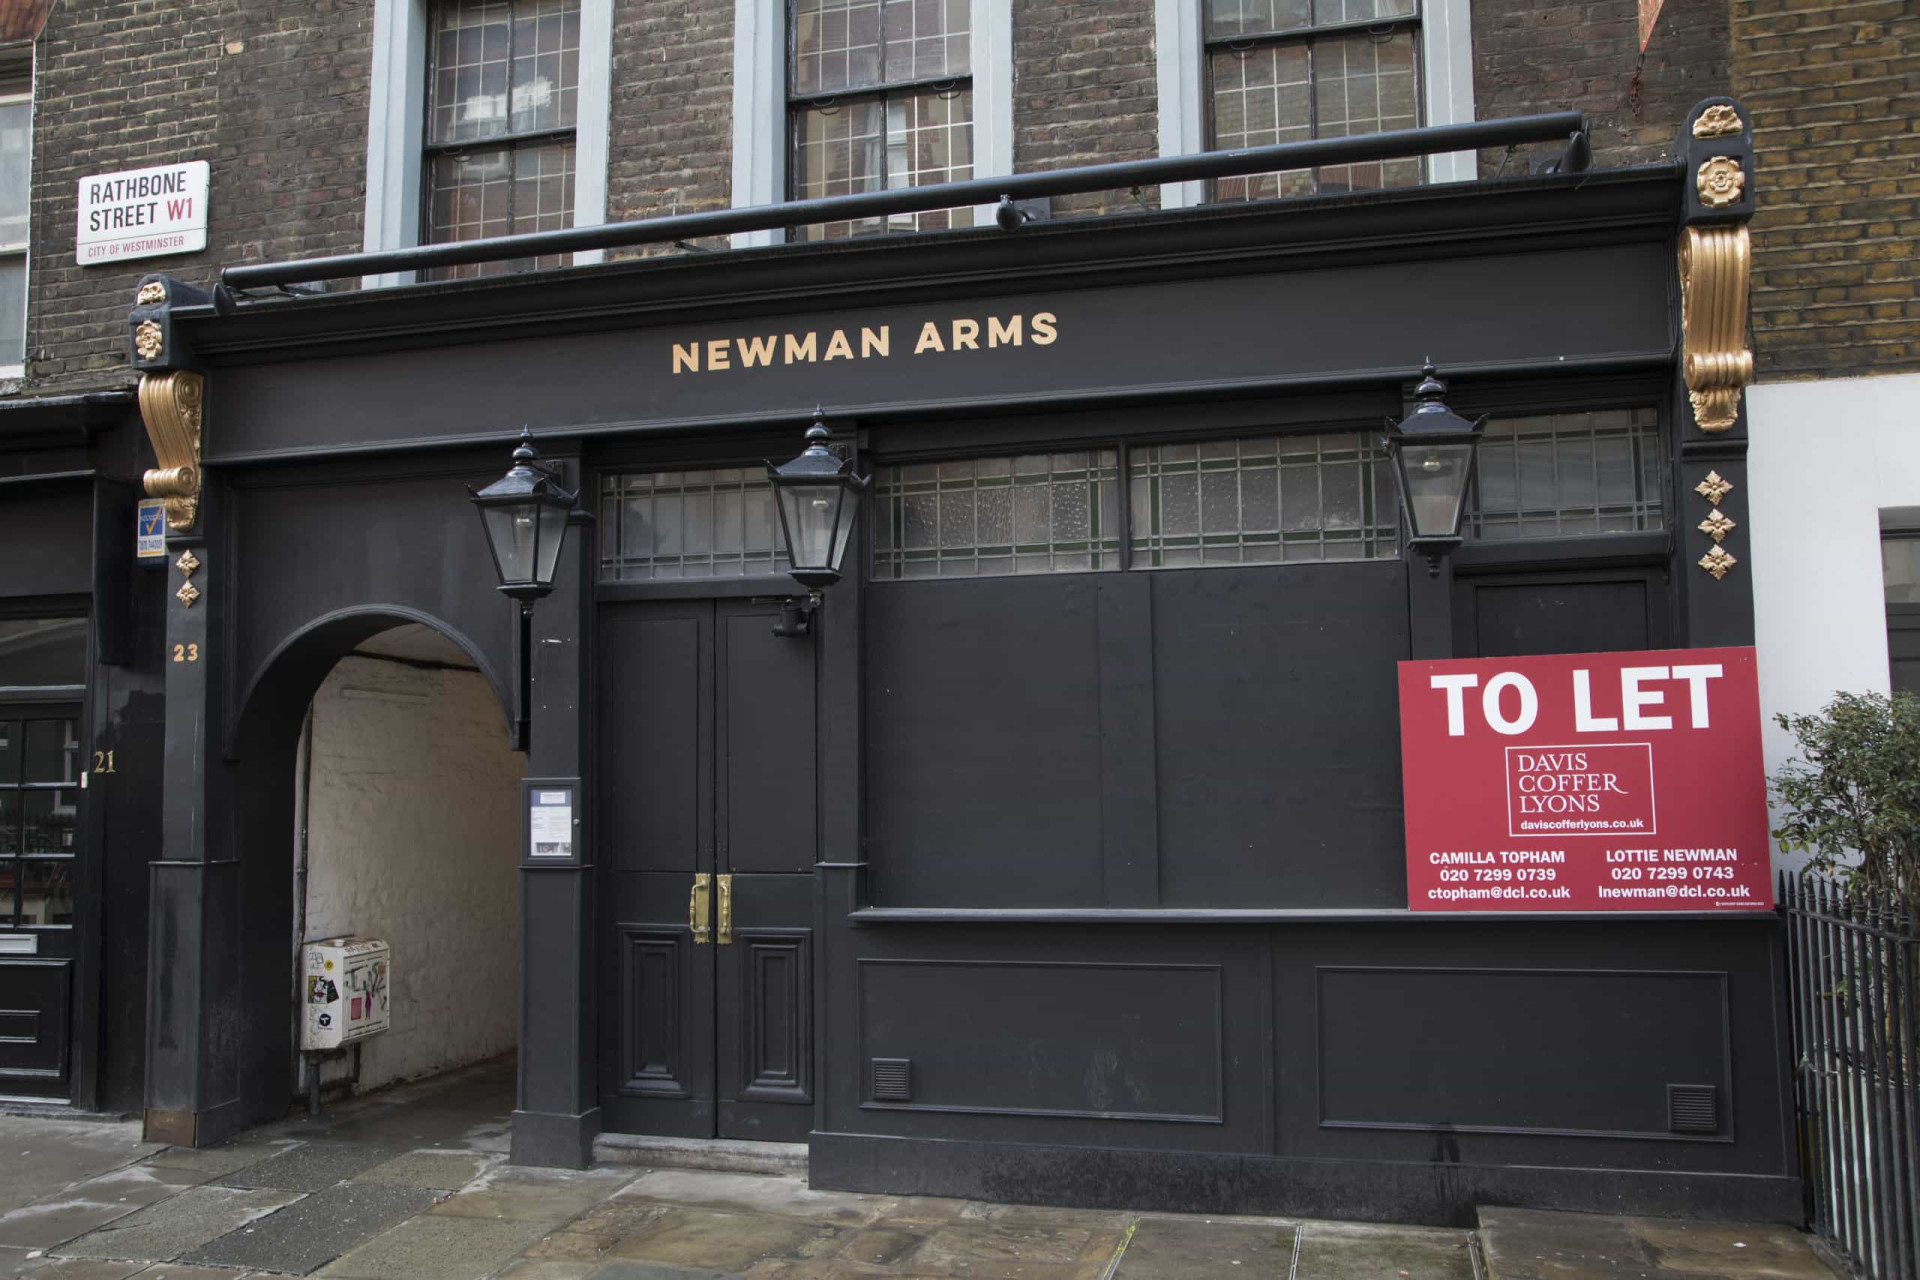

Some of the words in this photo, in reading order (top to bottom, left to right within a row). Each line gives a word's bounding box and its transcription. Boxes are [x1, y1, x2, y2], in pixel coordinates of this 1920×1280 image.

[90, 171, 187, 204] RATHBONE
[90, 202, 158, 232] STREET
[167, 197, 193, 221] W1
[88, 246, 107, 258] CITY
[109, 244, 120, 255] OF
[122, 235, 184, 253] WESTMINSTER
[672, 325, 890, 374] NEWMAN
[914, 312, 1058, 354] ARMS
[173, 643, 199, 662] 23
[1430, 671, 1539, 737] TO
[1572, 663, 1724, 733] LET
[93, 750, 117, 774] 21
[1518, 752, 1588, 773] DAVIS
[1518, 773, 1629, 794] COFFER
[1519, 793, 1601, 814] LYONS
[1520, 817, 1645, 831] daviscofferlyons.co.uk
[1429, 851, 1496, 865] CAMILLA
[1500, 850, 1565, 863] TOPHAM
[1605, 849, 1659, 863] LOTTIE
[1663, 848, 1738, 862] NEWMAN
[1439, 869, 1469, 881] 020
[1473, 868, 1512, 882] 7299
[1516, 868, 1557, 881] 0739
[1611, 867, 1642, 880] 020
[1646, 867, 1688, 880] 7299
[1692, 866, 1735, 879] 0743
[1427, 885, 1571, 901] ctopham@dcl.co.uk
[1598, 884, 1751, 898] lnewman@dcl.co.uk
